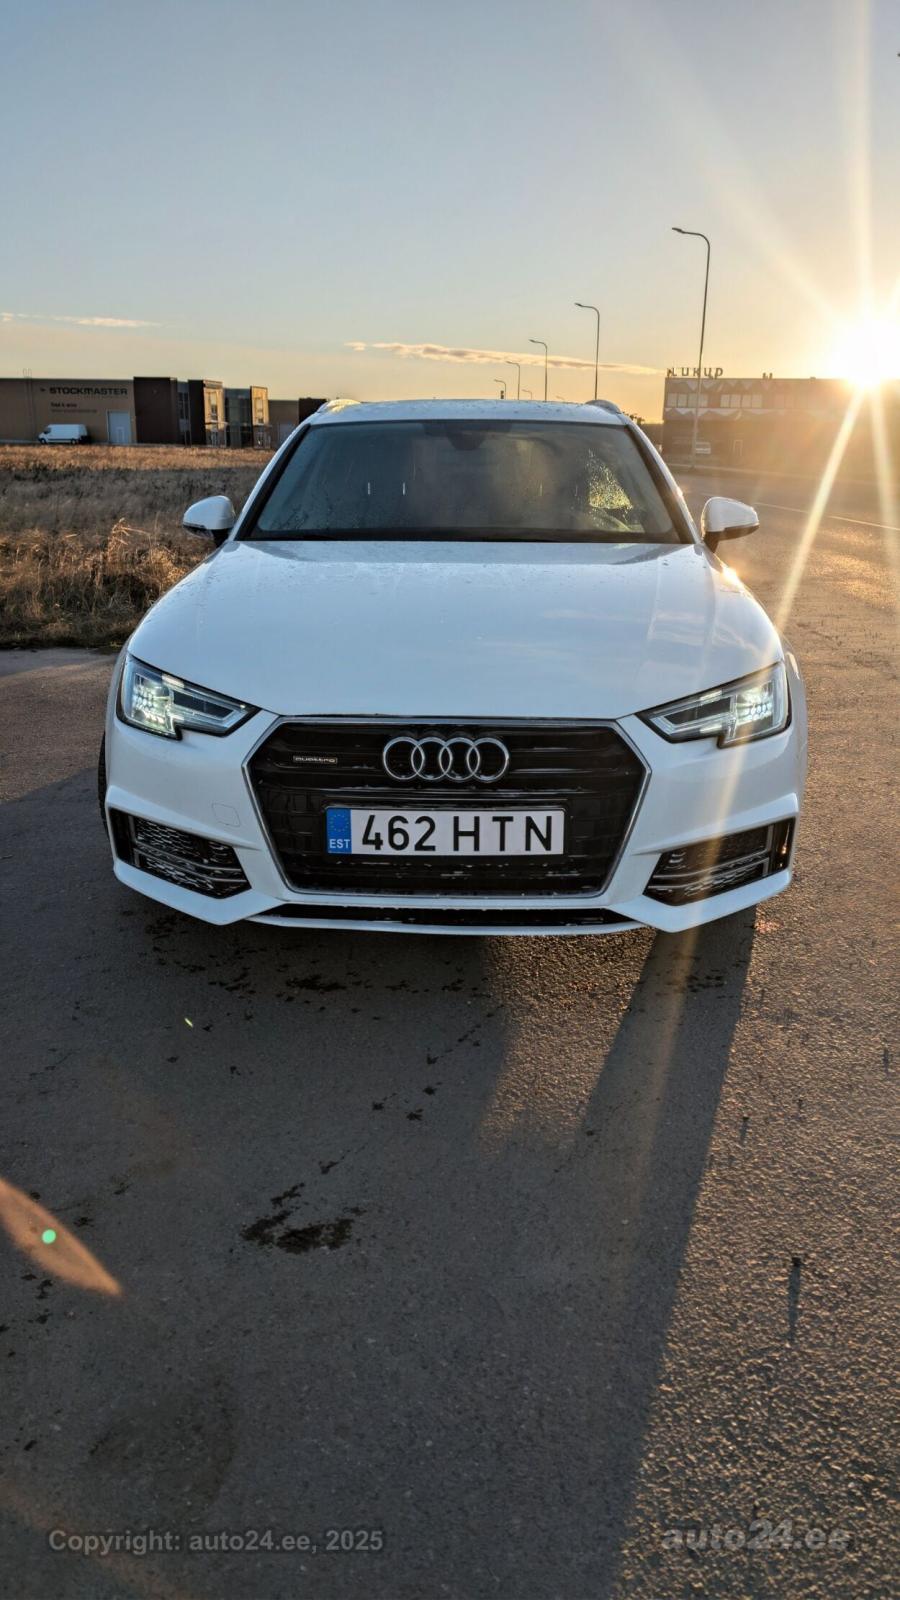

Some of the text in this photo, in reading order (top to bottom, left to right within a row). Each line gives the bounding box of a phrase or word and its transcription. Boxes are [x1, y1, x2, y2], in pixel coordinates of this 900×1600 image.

[49, 386, 128, 396] STOCKMASTER
[361, 814, 553, 852] 462 HTN
[329, 838, 351, 849] EST
